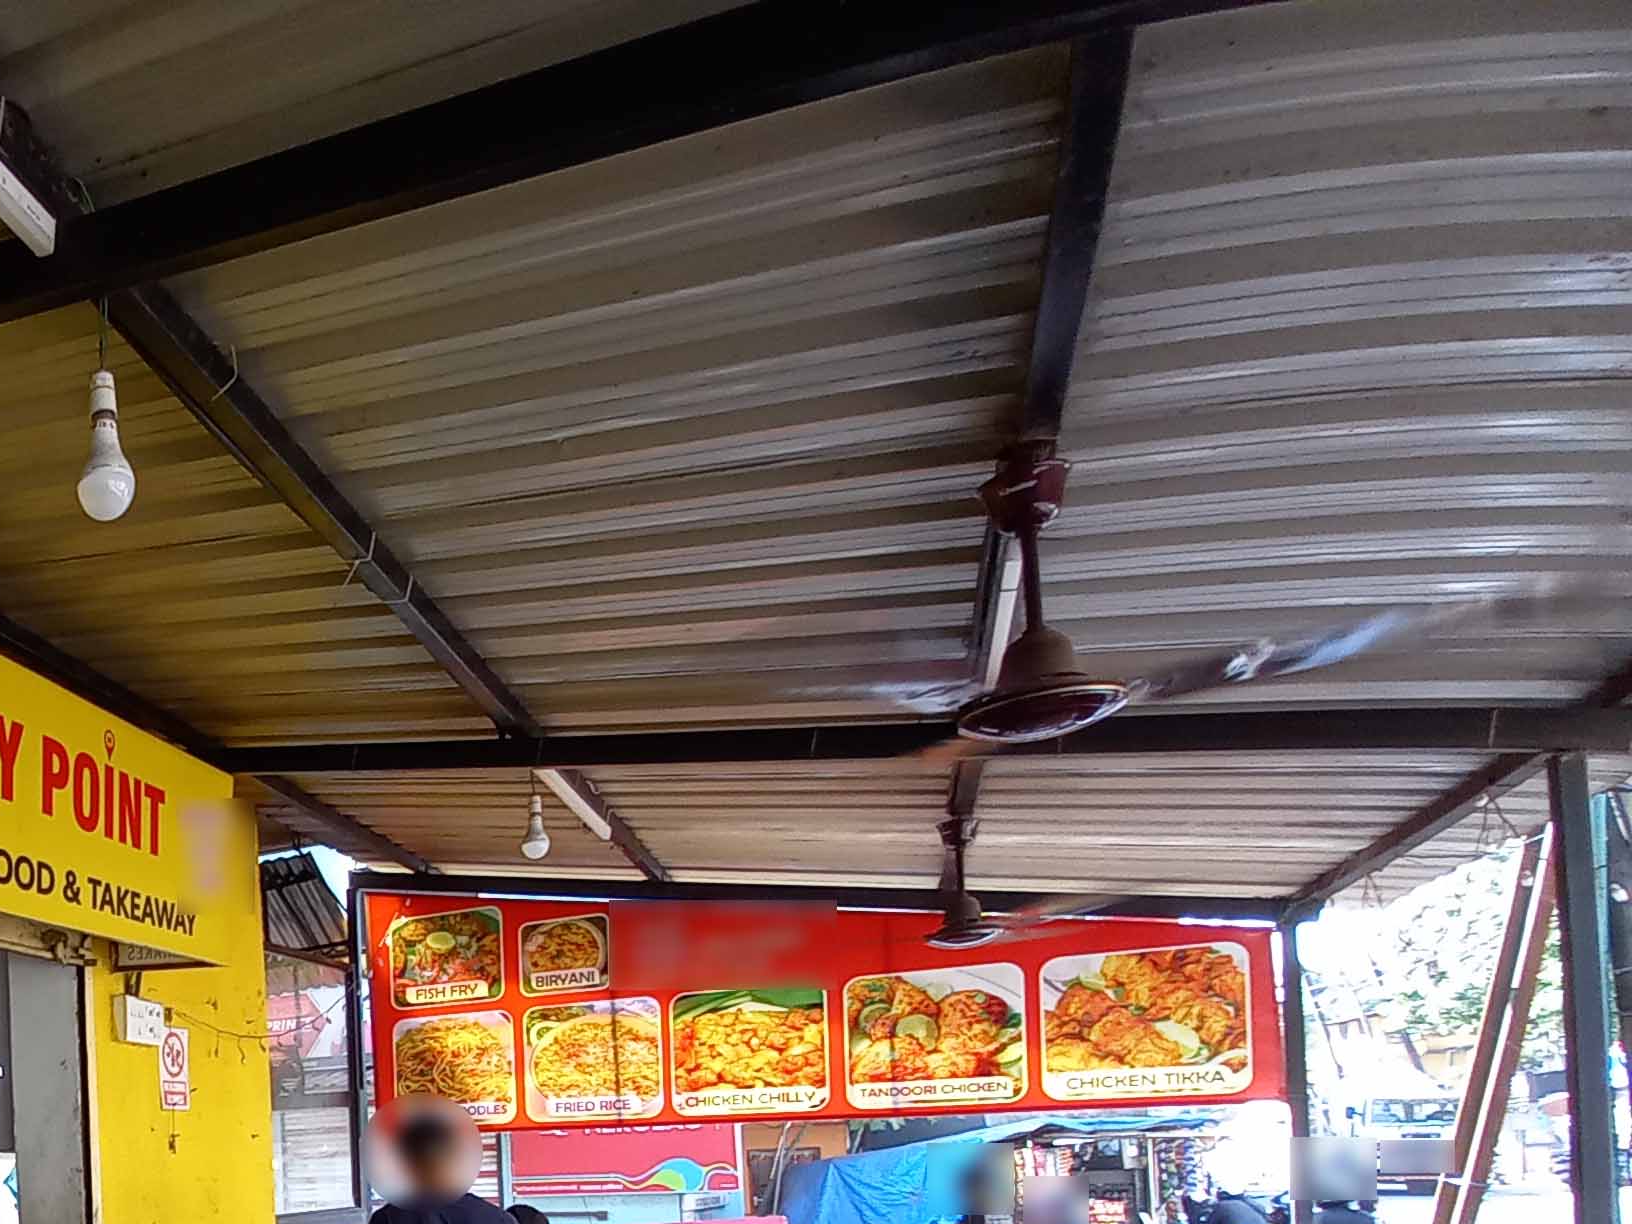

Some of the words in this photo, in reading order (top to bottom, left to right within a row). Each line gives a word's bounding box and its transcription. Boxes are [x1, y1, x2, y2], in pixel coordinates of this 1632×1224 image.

[41, 732, 166, 857] POINT
[62, 870, 82, 906] &
[87, 877, 196, 937] TAKEAWAY
[535, 971, 596, 988] BIRYANI
[415, 986, 446, 1000] FISH
[450, 983, 479, 997] FRY
[1066, 1074, 1156, 1090] CHICKEN
[1164, 1070, 1226, 1086] TIKKA
[860, 1085, 938, 1098] TANDOORI
[940, 1081, 1009, 1095] CHICKEN
[555, 1101, 596, 1113] FRIED
[599, 1099, 632, 1112] RICE
[685, 1094, 753, 1108] CHICKEN
[758, 1090, 816, 1105] CHILLY
[464, 1104, 508, 1116] ODLES
